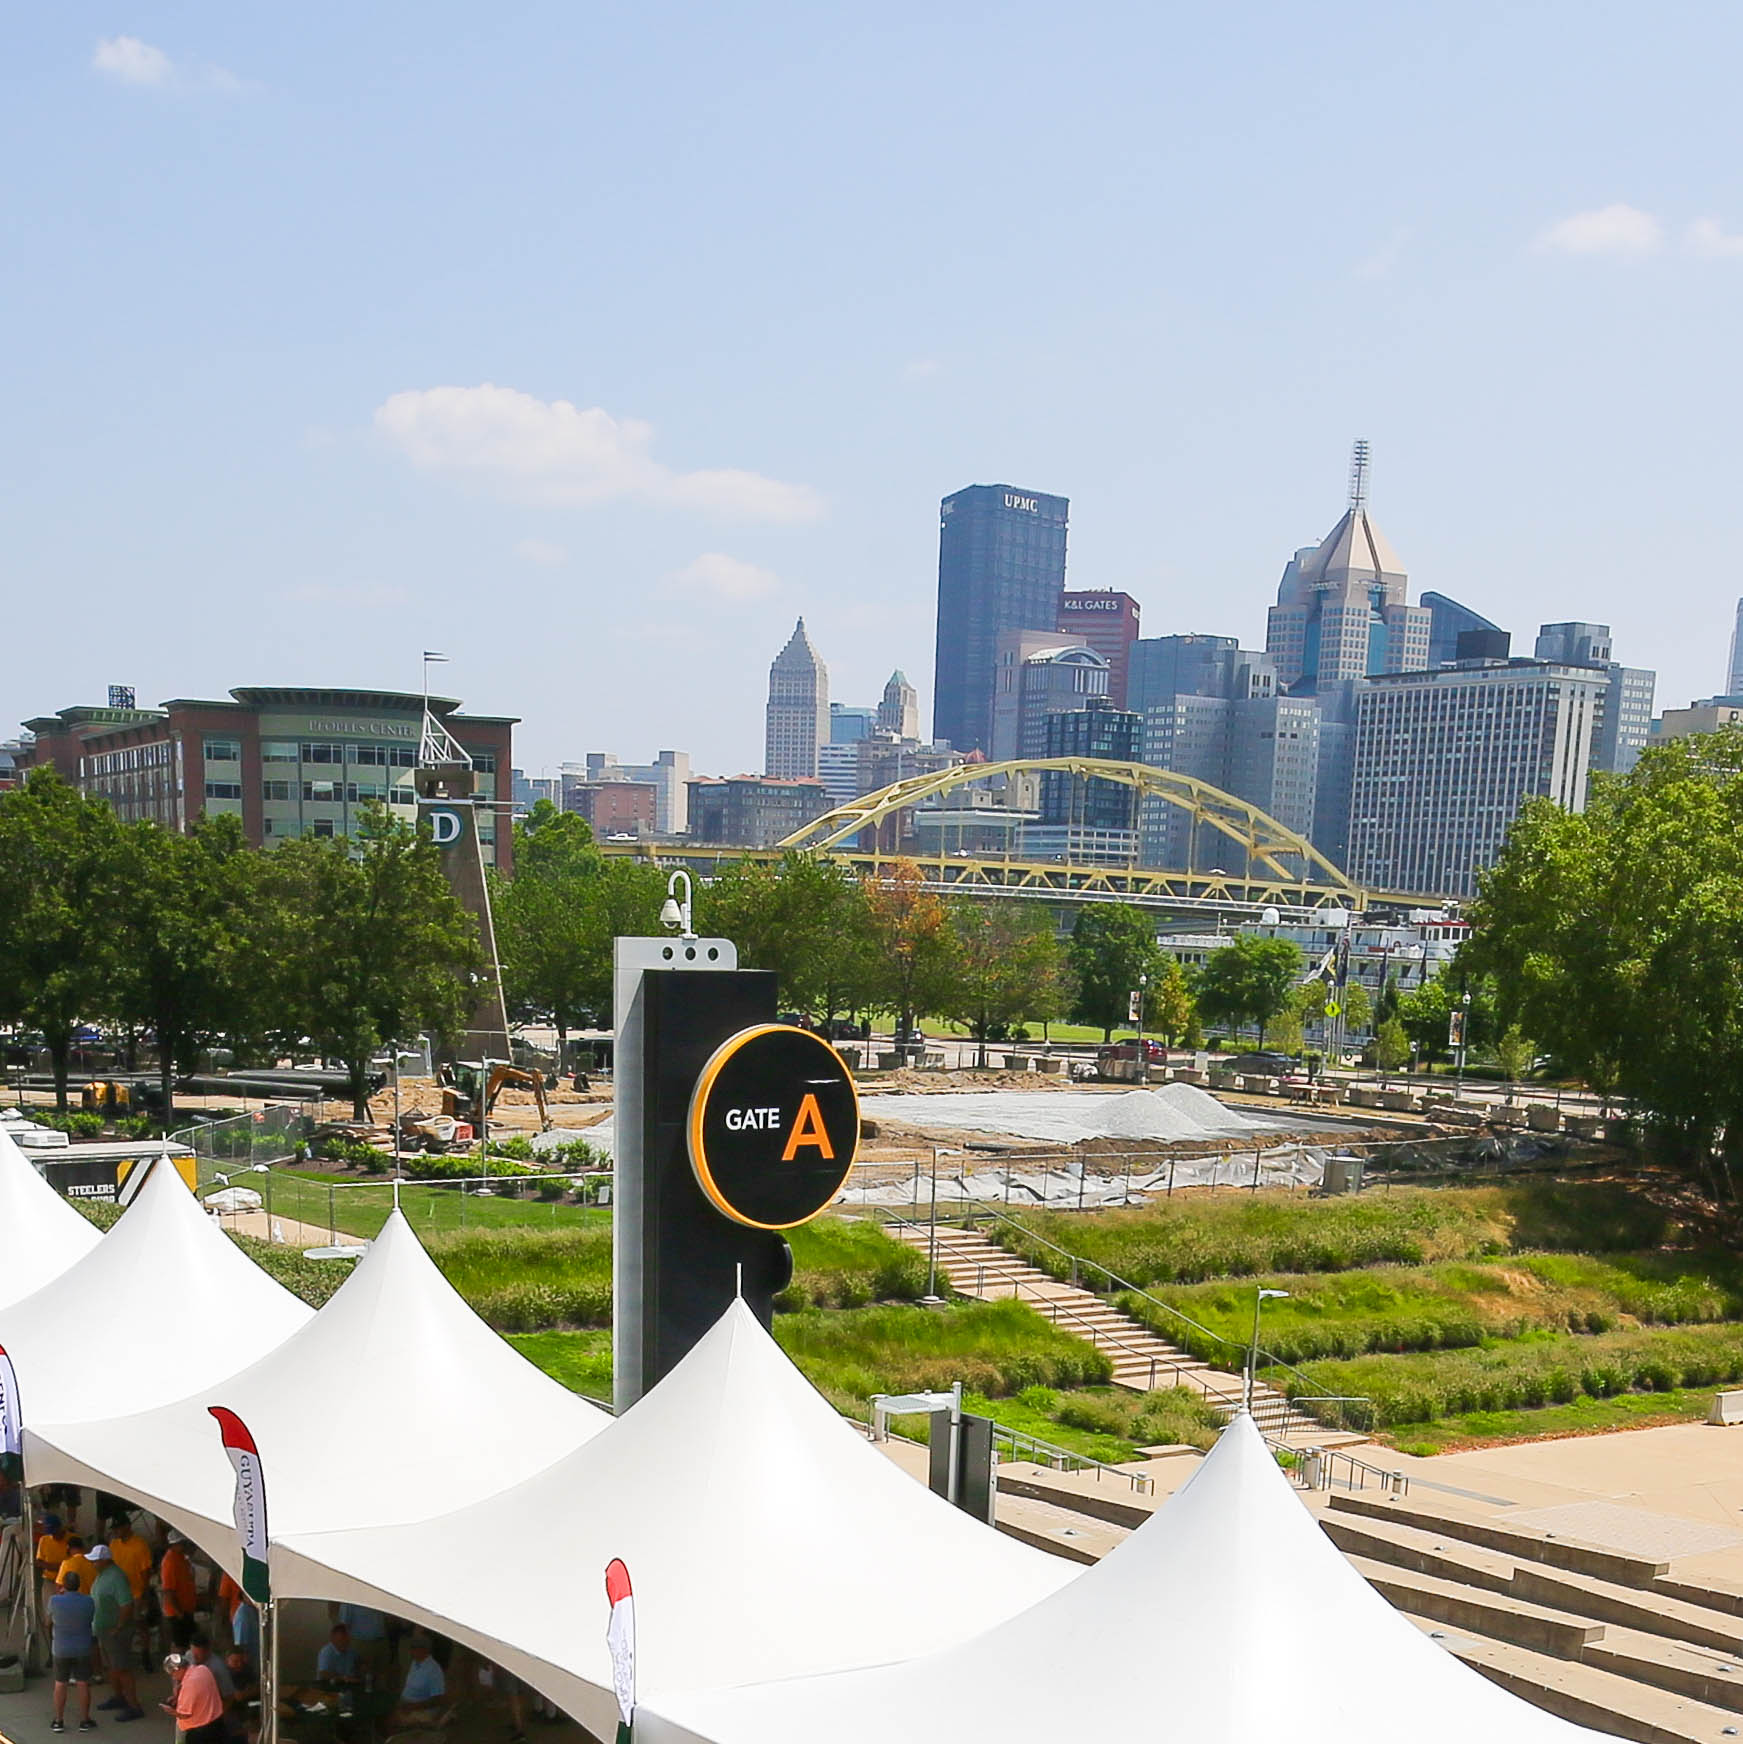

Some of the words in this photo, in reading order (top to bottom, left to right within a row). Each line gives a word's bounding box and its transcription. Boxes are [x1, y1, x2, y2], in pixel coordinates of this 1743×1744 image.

[1004, 493, 1038, 512] UPMC
[1064, 600, 1084, 610] K&L
[1085, 600, 1118, 610] GATES
[369, 722, 417, 738] CENTER
[429, 812, 461, 843] D
[725, 1106, 781, 1132] GATE
[781, 1092, 835, 1161] A
[67, 1184, 115, 1196] STEELERS
